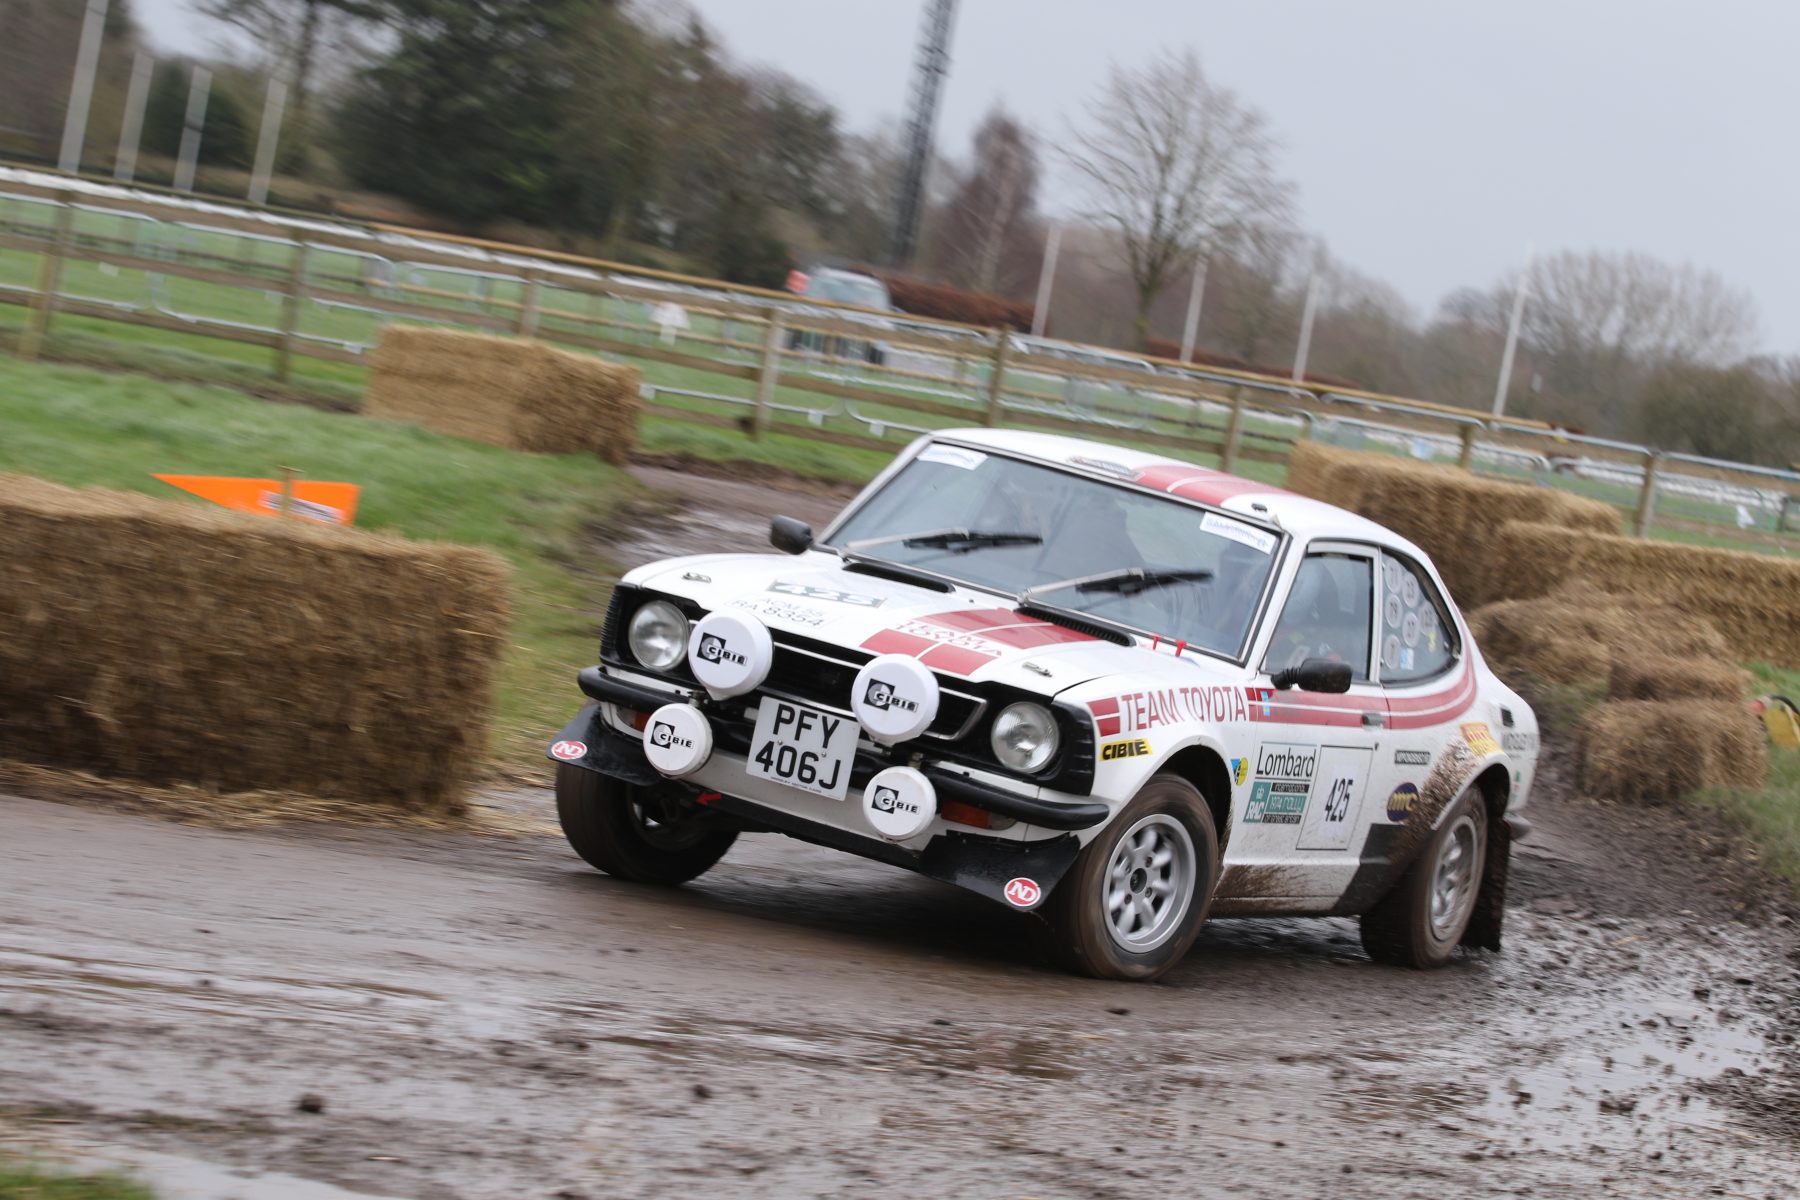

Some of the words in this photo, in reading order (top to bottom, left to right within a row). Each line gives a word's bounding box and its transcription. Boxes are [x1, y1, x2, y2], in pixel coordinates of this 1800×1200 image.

[773, 703, 840, 749] PFY
[1121, 688, 1185, 732] TEAM
[1179, 686, 1247, 723] TOYOTA
[755, 740, 841, 790] 406J
[1256, 745, 1316, 777] Lombard
[1246, 801, 1265, 820] RAC
[1325, 778, 1353, 822] 425
